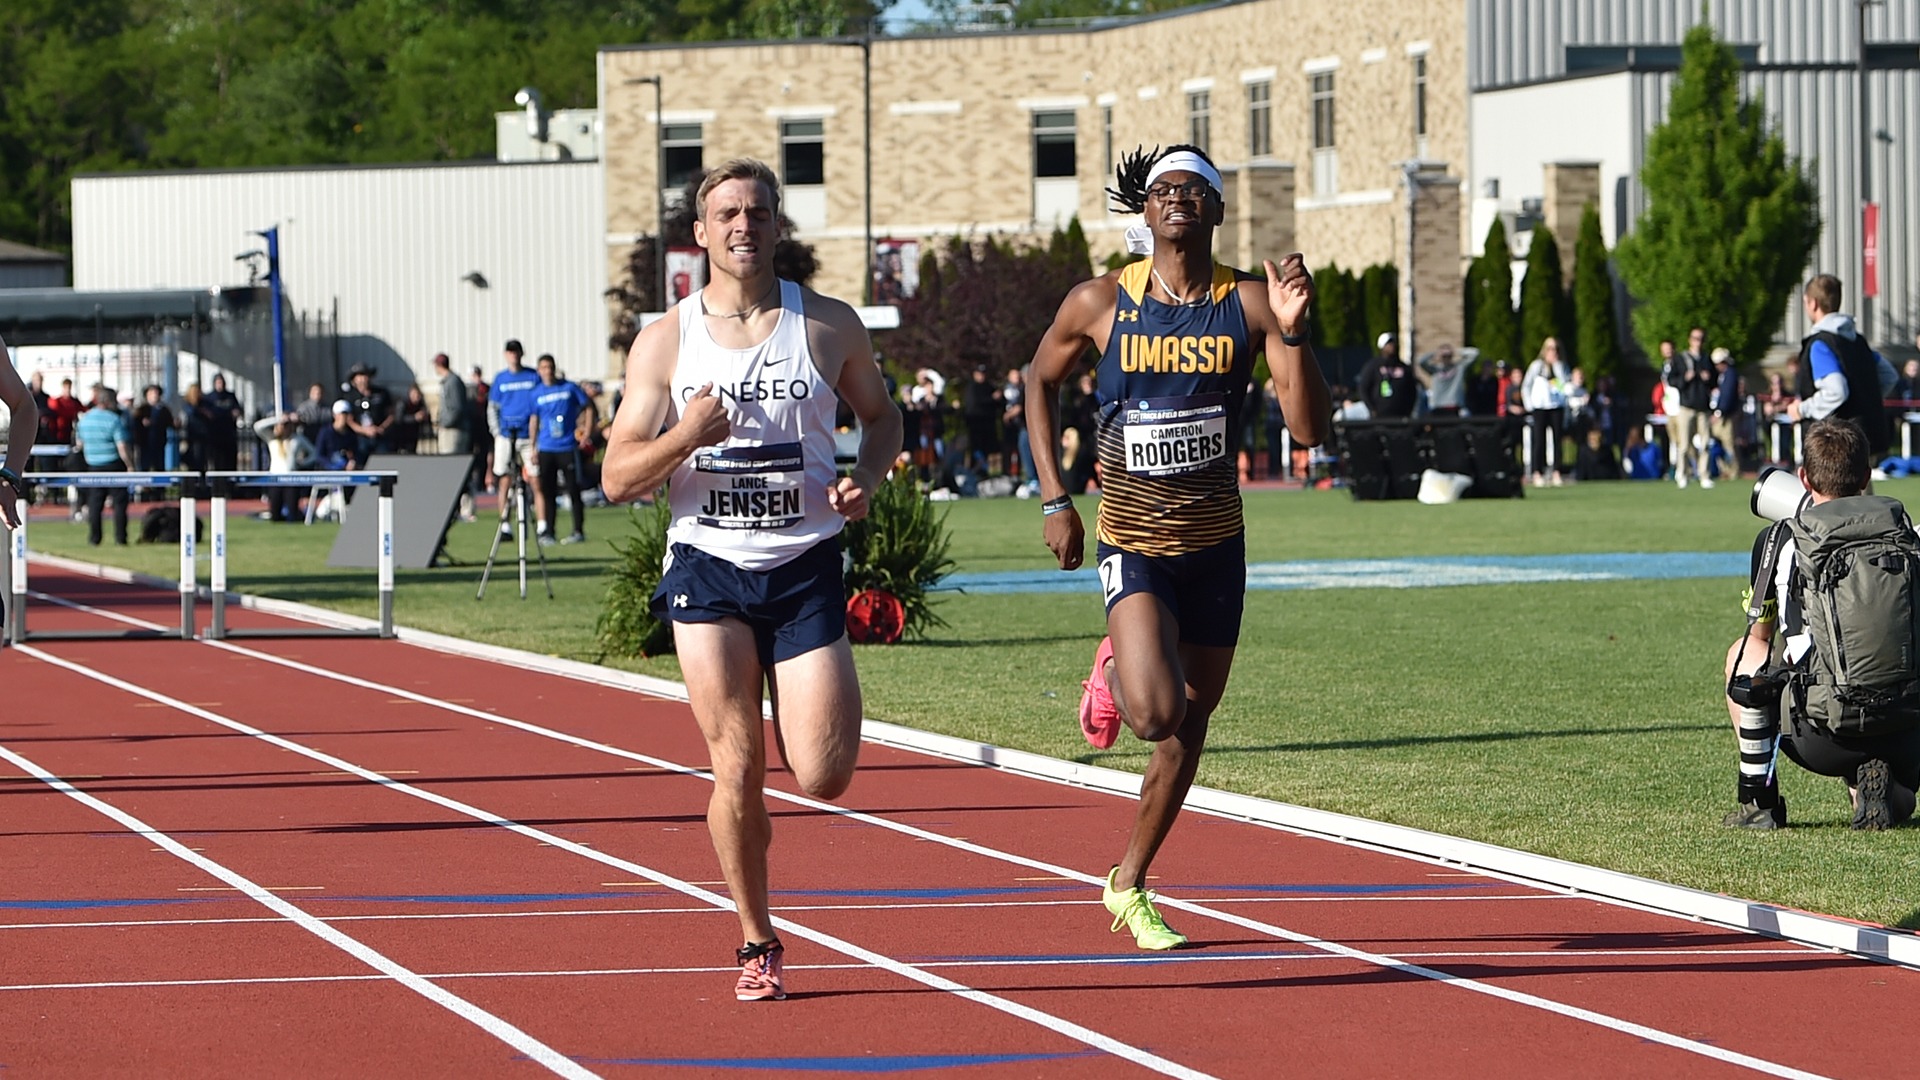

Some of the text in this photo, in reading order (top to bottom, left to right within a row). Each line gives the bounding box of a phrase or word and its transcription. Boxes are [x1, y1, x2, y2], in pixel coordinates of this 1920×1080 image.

[1120, 333, 1235, 374] UMASSD
[682, 379, 809, 404] NESEO
[1150, 423, 1203, 440] CAMERON
[1131, 432, 1223, 467] RODGERS
[731, 477, 768, 489] LANCE
[702, 487, 800, 518] JENSEN
[1103, 561, 1116, 599] 2
